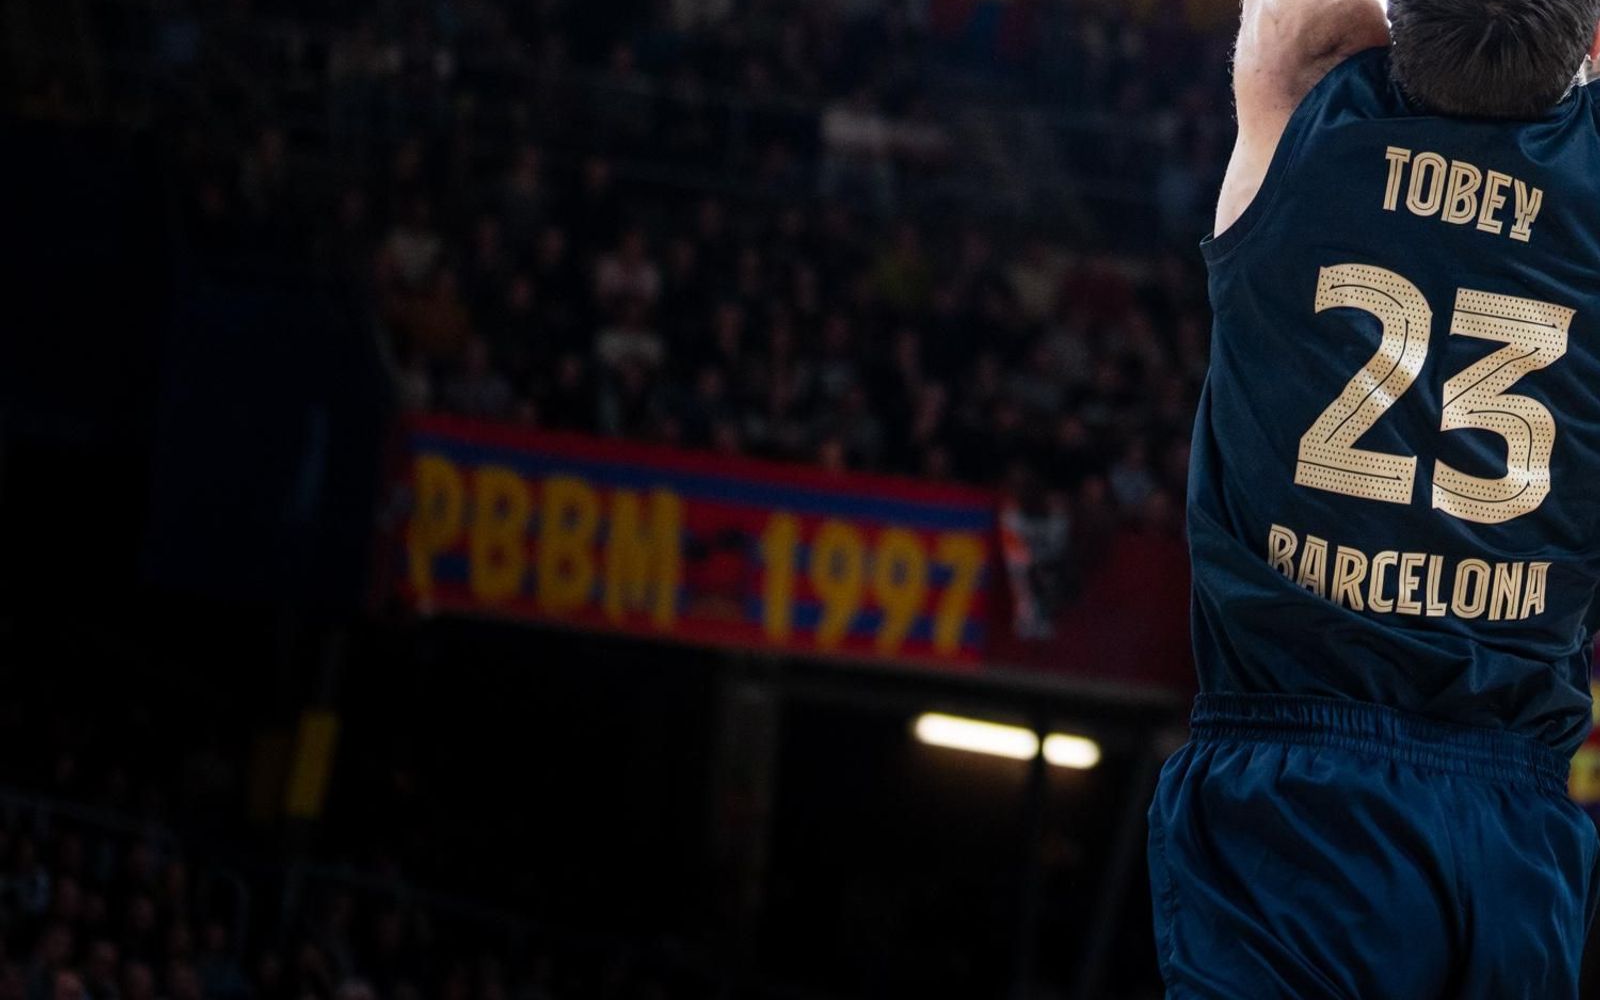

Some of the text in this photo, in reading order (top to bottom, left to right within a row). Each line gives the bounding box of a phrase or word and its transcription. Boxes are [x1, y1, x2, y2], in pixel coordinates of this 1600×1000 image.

[1383, 146, 1544, 242] TOBEY
[1294, 263, 1577, 524] 23
[407, 452, 987, 656] PBBM 1997
[1266, 523, 1552, 622] BARCELONA
